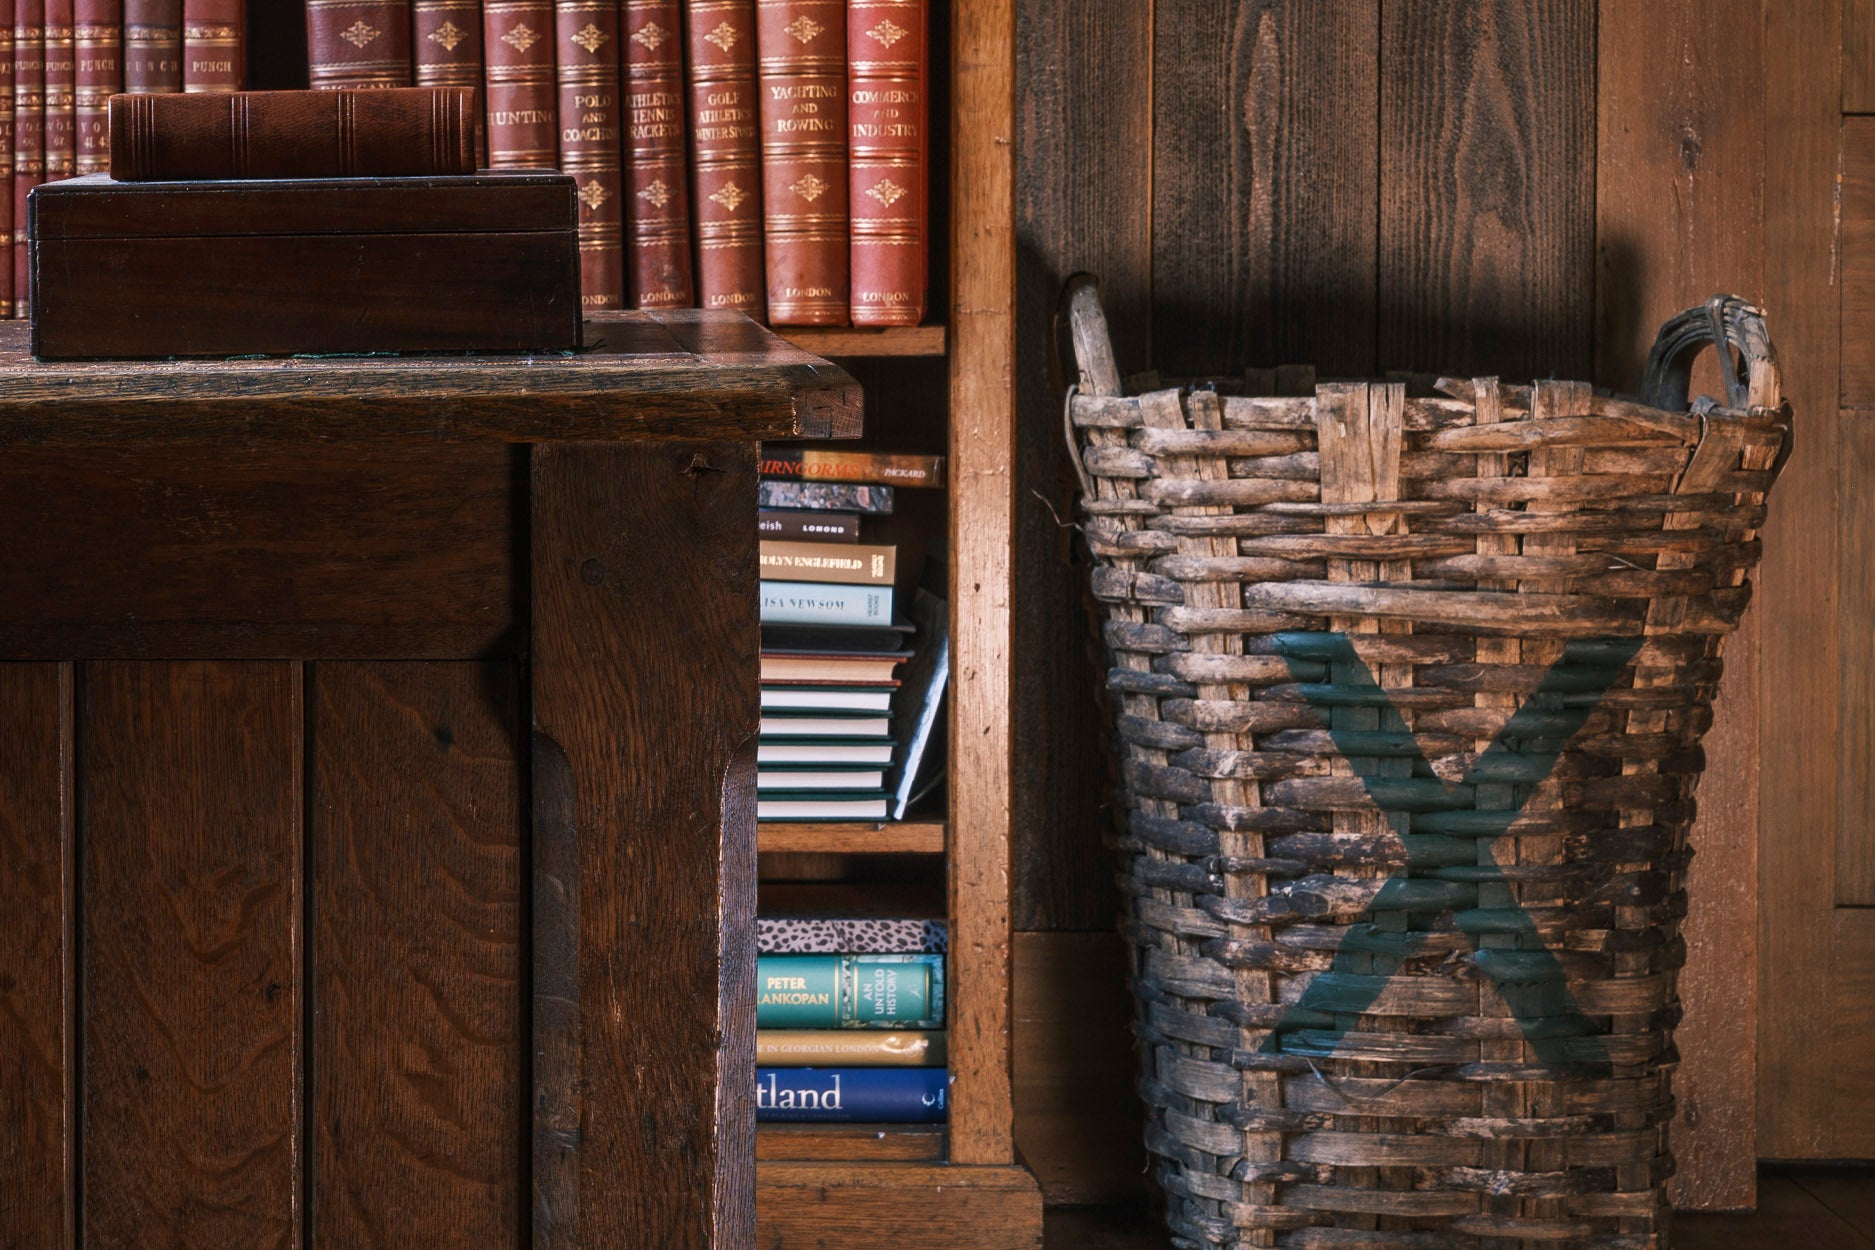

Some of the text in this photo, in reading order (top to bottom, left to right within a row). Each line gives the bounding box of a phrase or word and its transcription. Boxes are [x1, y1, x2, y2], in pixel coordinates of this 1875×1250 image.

[80, 59, 114, 72] PUNCH
[192, 61, 232, 73] PUNCH
[708, 92, 739, 106] GOLF
[771, 86, 837, 99] YACHTING
[574, 95, 611, 109] POLO
[792, 103, 818, 114] AND
[582, 112, 607, 124] AND
[632, 108, 675, 123] TENNIS
[874, 108, 899, 119] AND
[630, 124, 680, 140] RACKETS
[777, 119, 833, 132] ROWING
[852, 123, 919, 137] INDUSTRY
[640, 290, 686, 304] LONDON
[785, 287, 832, 298] LONDON
[862, 292, 909, 302] LONDON
[581, 294, 618, 305] ONDON
[711, 293, 756, 306] LONDON
[884, 467, 926, 479] PACKARD
[802, 525, 844, 534] LOMOND
[794, 556, 863, 570] ENGLEFIELD
[789, 598, 845, 611] NEWSOM
[767, 977, 807, 990] PETER
[863, 983, 873, 1000] AN
[875, 968, 885, 1015] UNTOLD
[886, 968, 897, 1015] HISTORY
[757, 993, 829, 1005] ANKOPAN
[766, 1044, 779, 1053] IN
[780, 1044, 834, 1053] GEORGIAN
[835, 1044, 881, 1054] LONDON
[757, 1072, 843, 1110] tland
